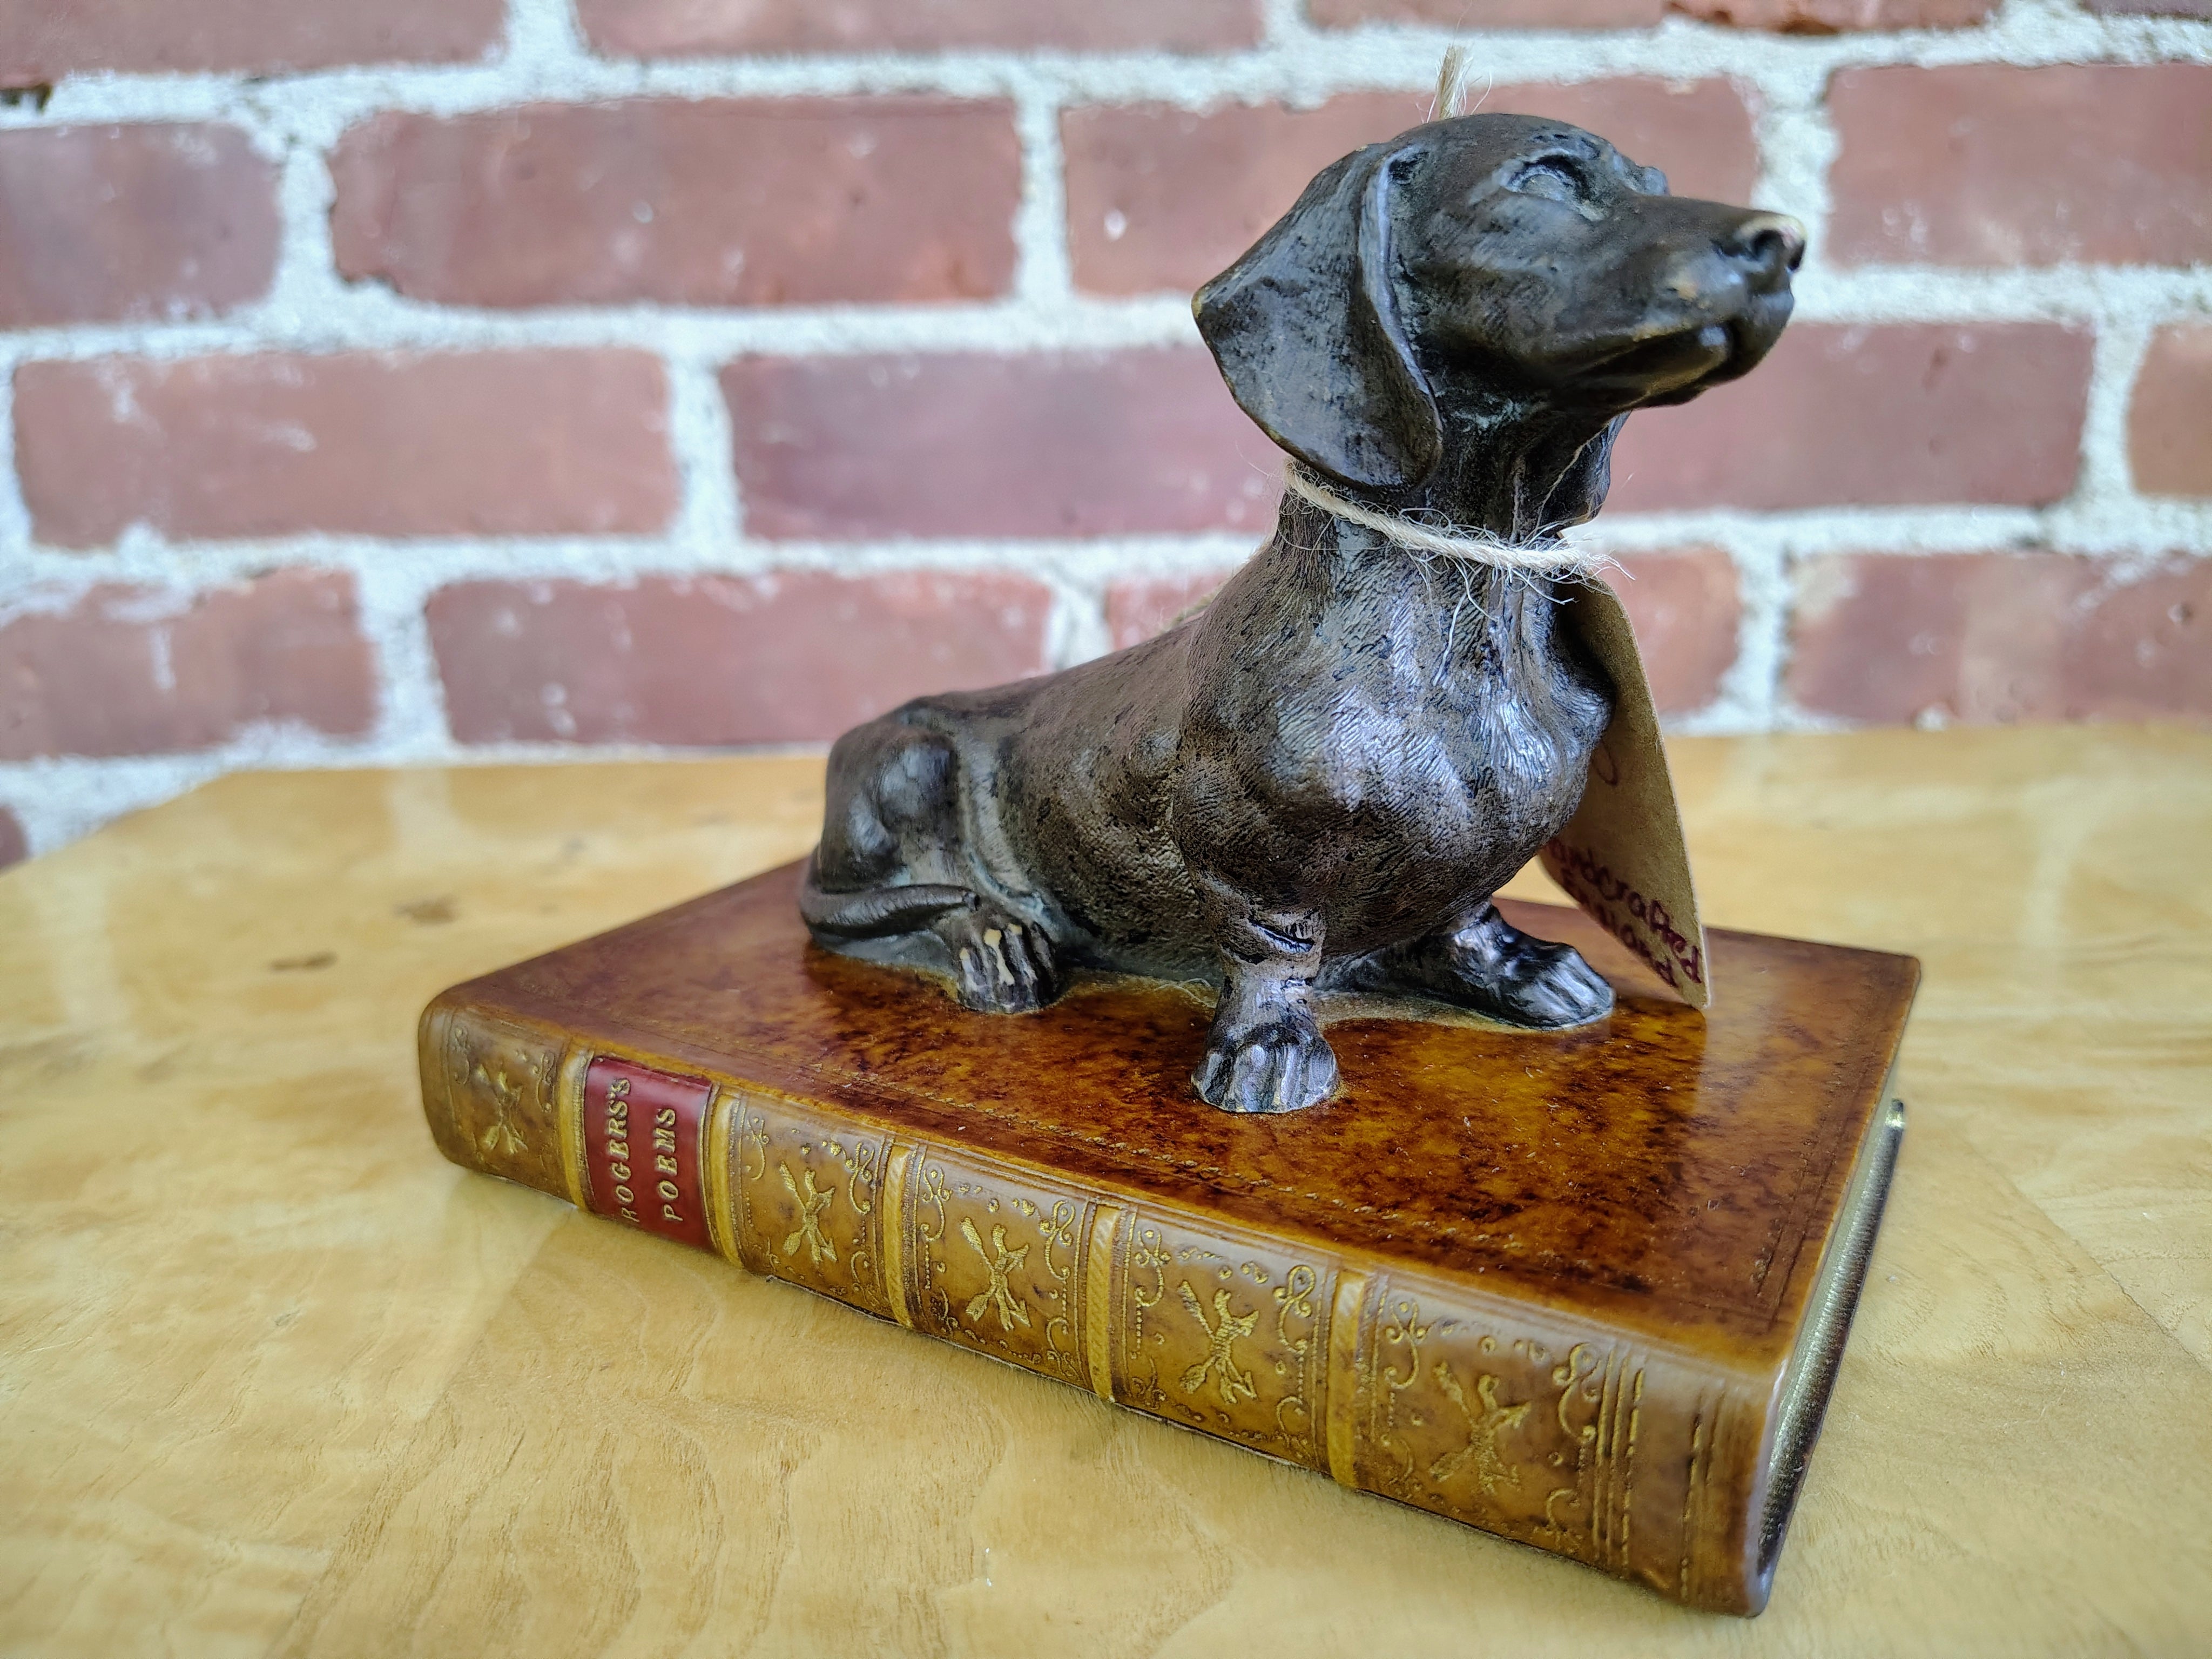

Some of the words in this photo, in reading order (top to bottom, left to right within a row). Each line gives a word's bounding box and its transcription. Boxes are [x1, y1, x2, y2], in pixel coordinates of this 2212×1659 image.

[1545, 838, 1702, 983] andcrafted
[607, 1078, 640, 1223] ROGERS'S
[654, 1109, 683, 1222] POEMS
